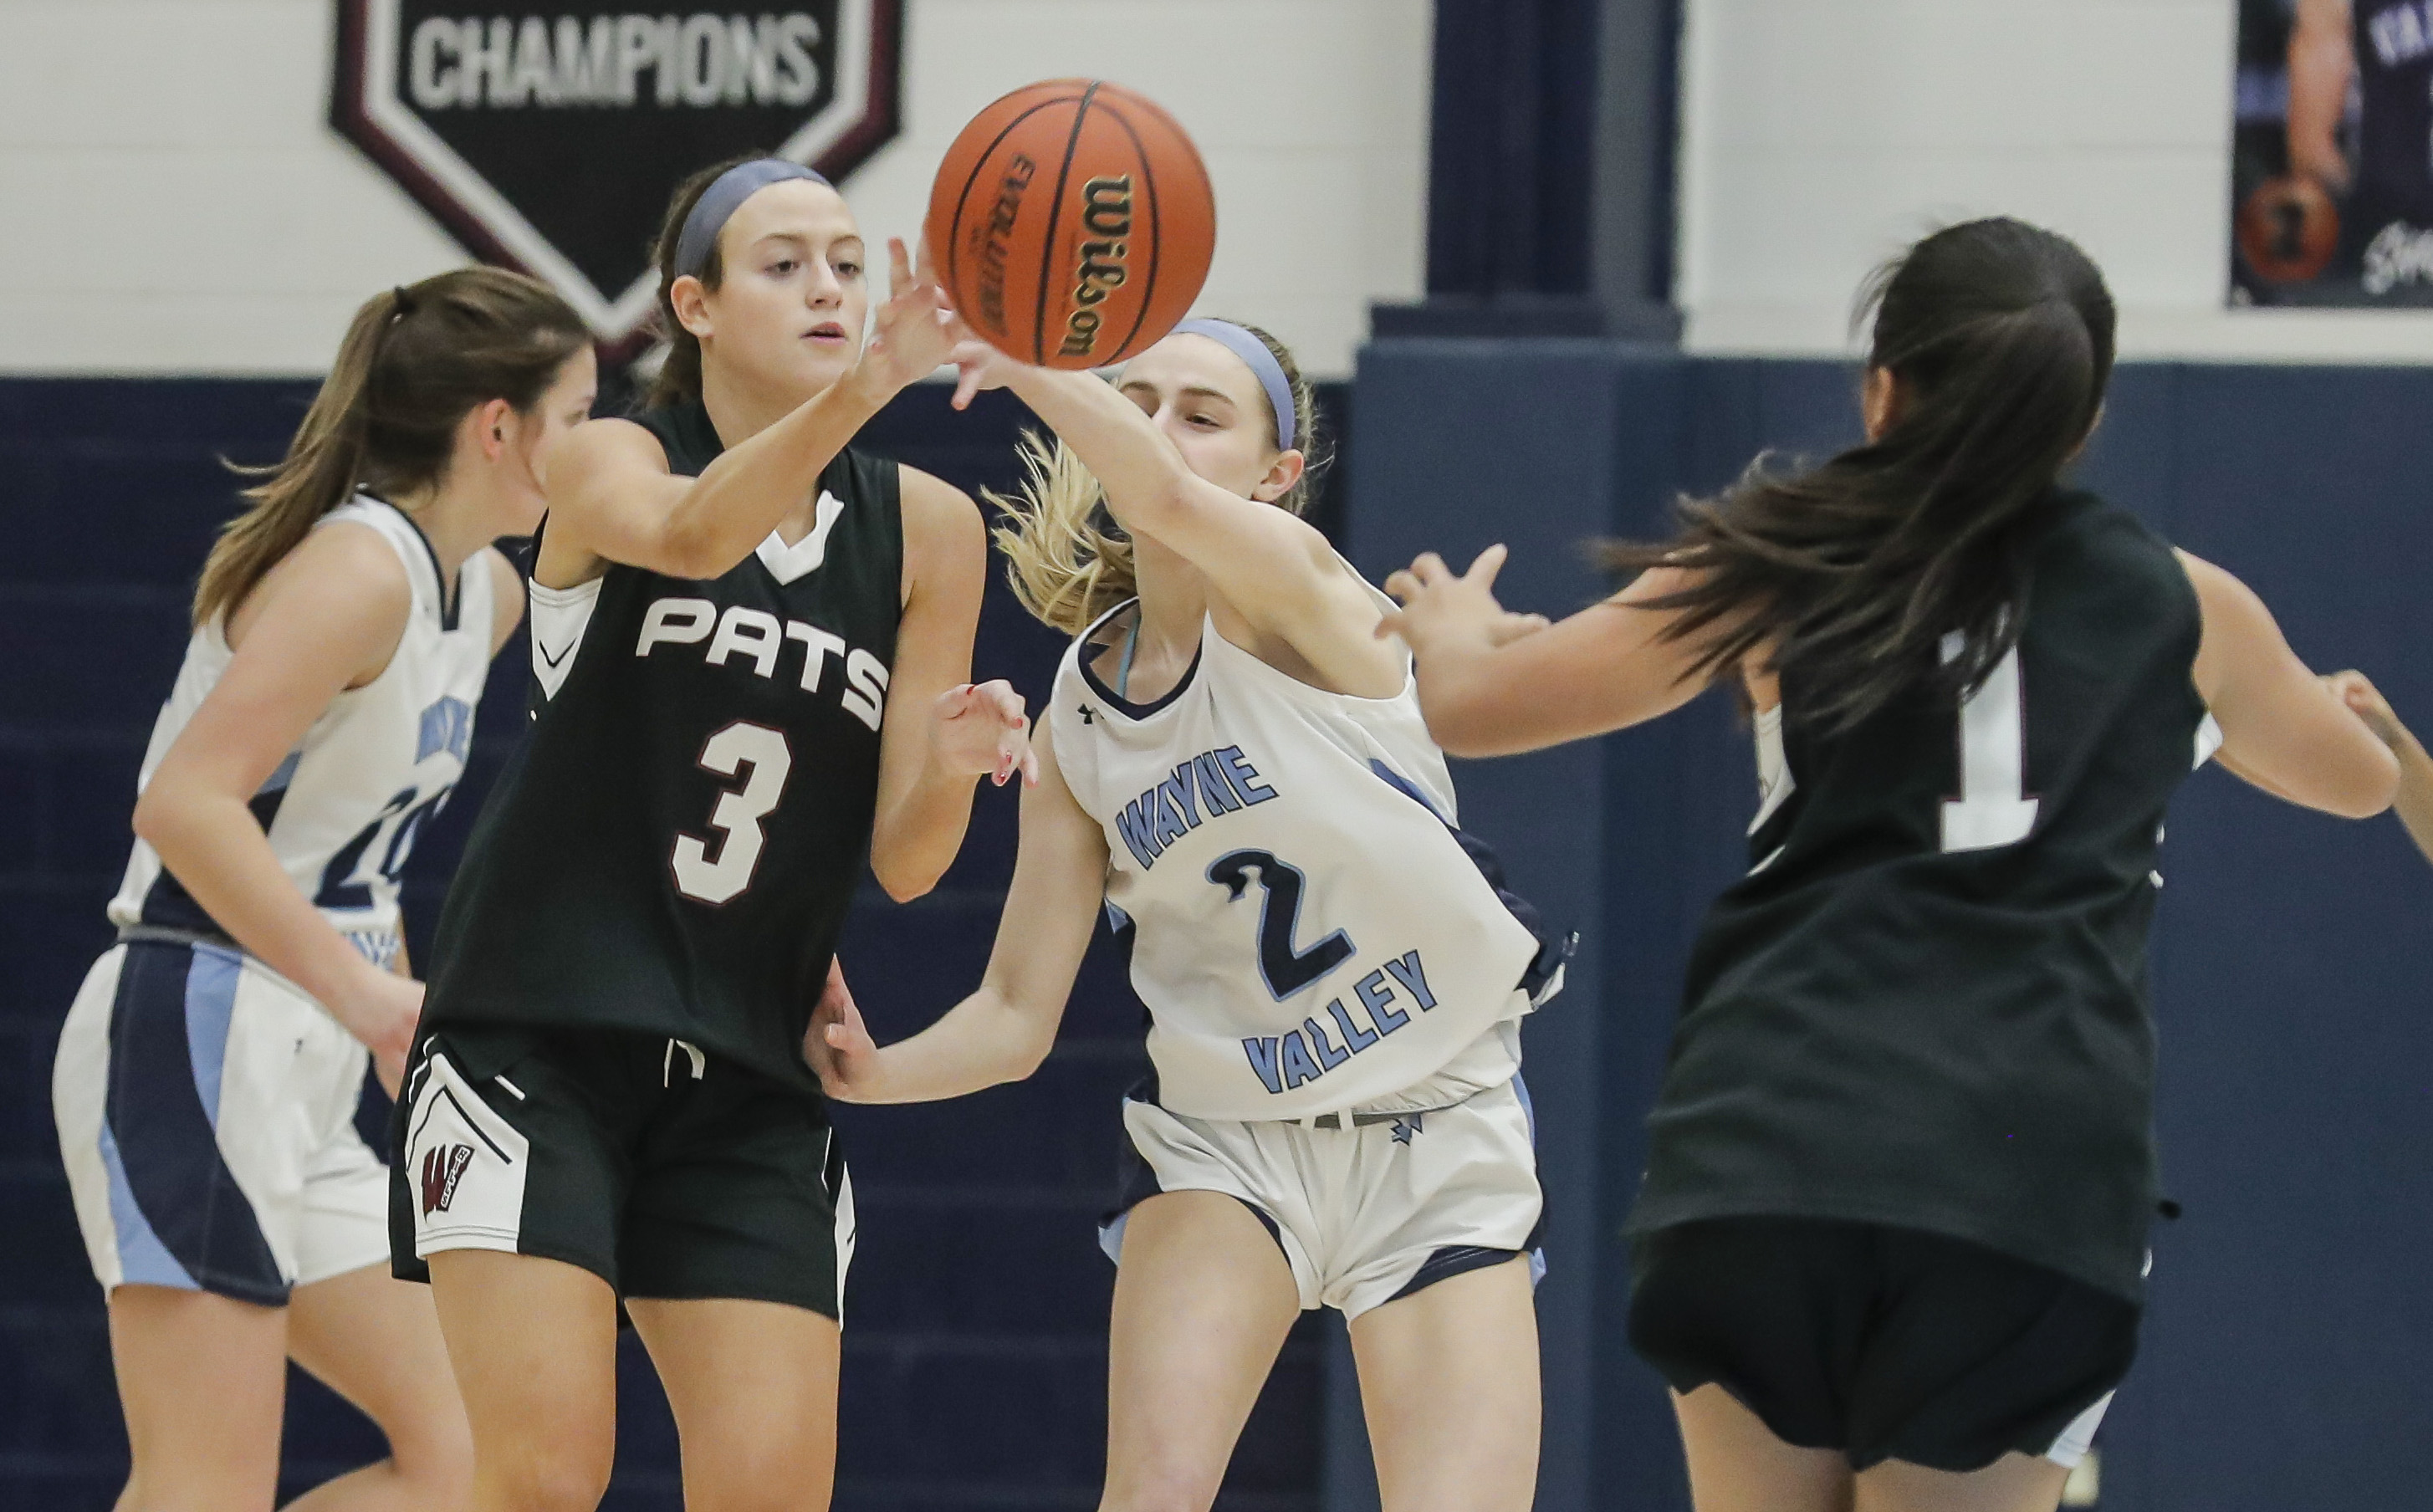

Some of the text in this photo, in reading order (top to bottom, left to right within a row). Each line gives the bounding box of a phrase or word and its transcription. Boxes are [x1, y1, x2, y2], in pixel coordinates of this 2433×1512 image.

[411, 13, 820, 109] CHAMPIONS
[1058, 173, 1132, 357] Wilson
[635, 596, 890, 733] PATS
[1939, 602, 2039, 854] 1
[672, 721, 792, 905] 3
[1115, 744, 1280, 871] WAYNE
[1204, 847, 1357, 1003] 2
[1241, 948, 1438, 1094] VALLEY
